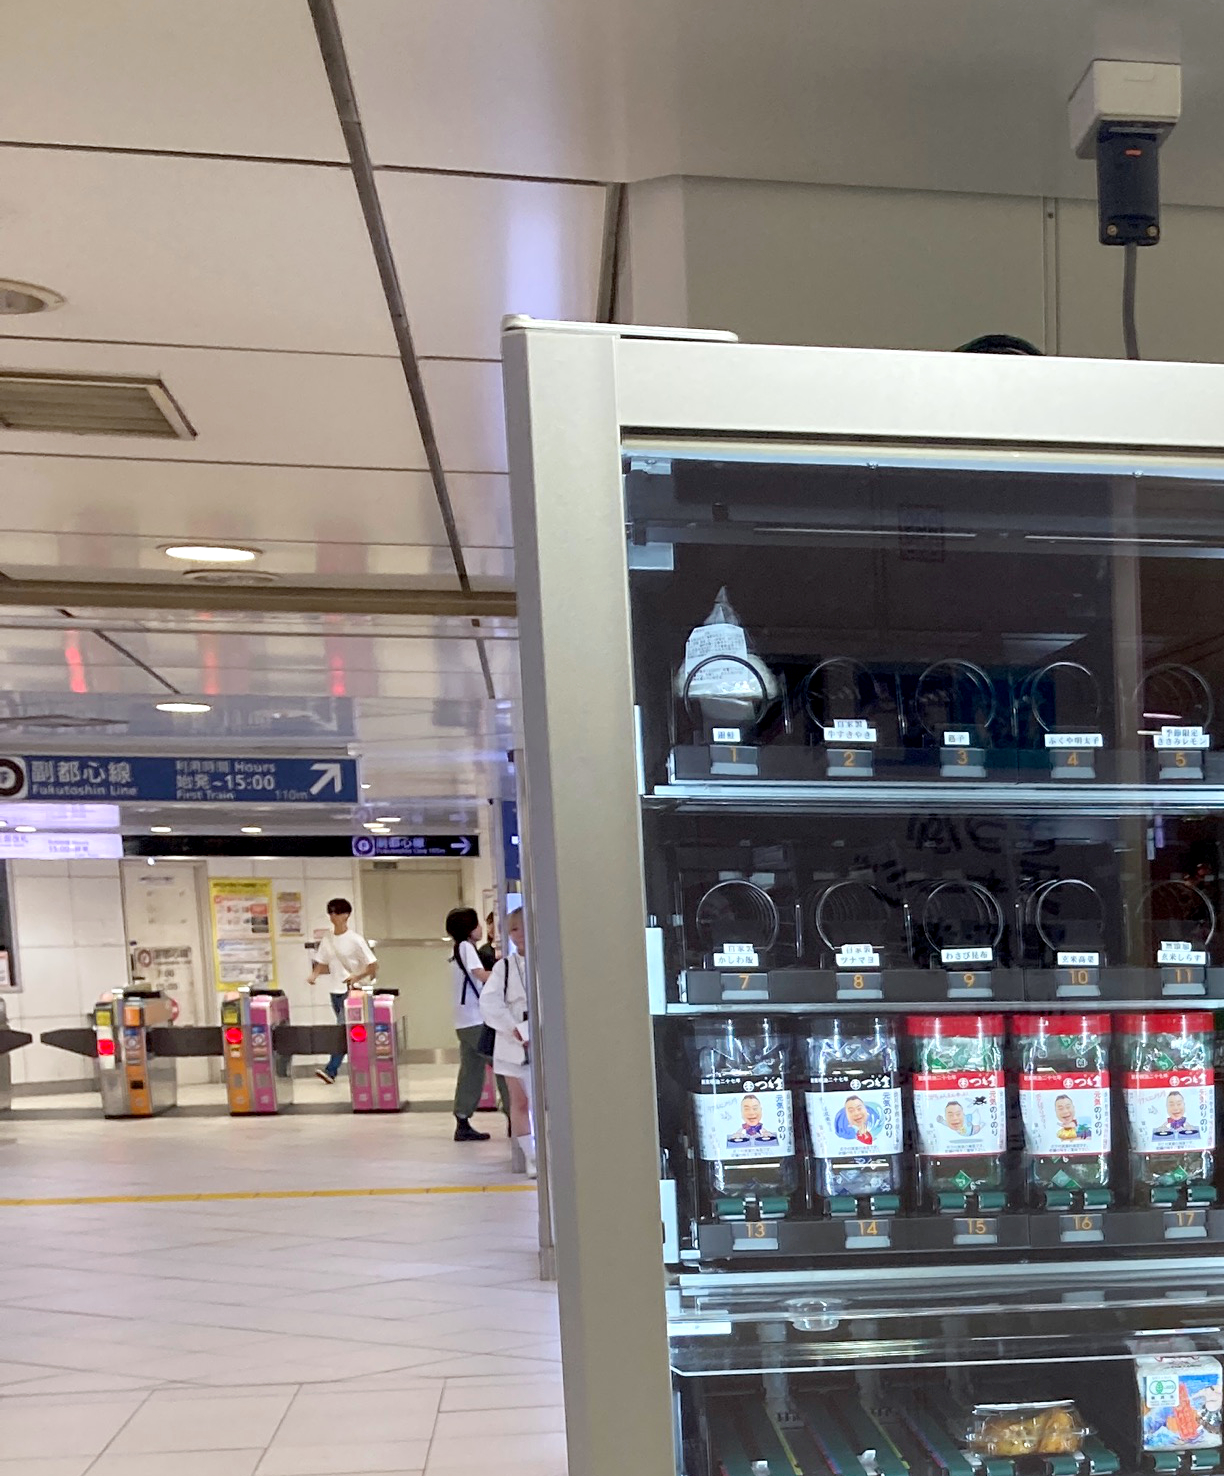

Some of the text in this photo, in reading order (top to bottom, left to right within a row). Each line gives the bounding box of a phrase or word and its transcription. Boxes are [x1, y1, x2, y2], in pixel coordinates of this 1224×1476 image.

[827, 730, 871, 740] 牛すきやき
[1165, 728, 1199, 738] 季節限定
[730, 748, 737, 762] 1
[843, 751, 855, 766] 2
[957, 750, 968, 765] 3
[1067, 752, 1078, 767] 4
[1175, 752, 1186, 767] 5
[31, 760, 133, 784] 副都心線
[234, 761, 275, 773] Hours
[32, 785, 137, 797] Fukutoshin Line
[176, 789, 234, 800] First Train
[840, 955, 875, 965] ツナマヨ
[945, 949, 988, 961] わさび昆布
[739, 975, 749, 989] 7
[853, 974, 864, 989] 8
[963, 973, 975, 988] 9
[1069, 969, 1089, 985] 10
[1175, 968, 1191, 983] 11
[776, 1094, 786, 1141] 元気のりのり
[882, 1092, 893, 1139] 元気のりのり
[988, 1091, 999, 1136] 元気のりのり
[1093, 1091, 1103, 1136] 元気のりのり
[1199, 1088, 1208, 1134] 元気のりのり
[1073, 1216, 1092, 1230] 16
[1176, 1211, 1194, 1226] 17
[746, 1223, 765, 1238] 13
[858, 1221, 878, 1235] 14
[967, 1219, 986, 1234] 15
